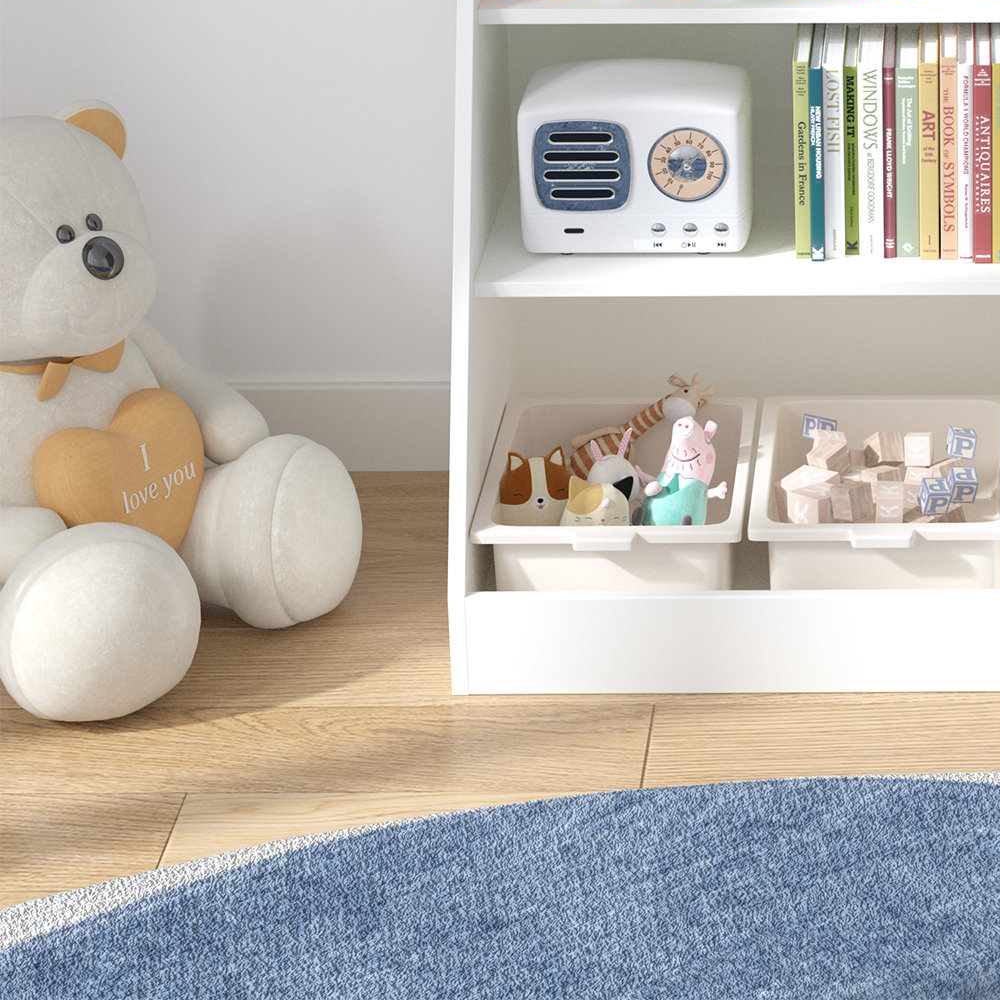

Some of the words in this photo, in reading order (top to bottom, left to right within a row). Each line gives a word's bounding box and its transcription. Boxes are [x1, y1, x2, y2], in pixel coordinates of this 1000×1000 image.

[826, 69, 840, 112] LOST
[846, 75, 855, 123] MAKING
[798, 121, 807, 160] Gardens
[826, 116, 840, 153] FISH
[846, 125, 855, 138] IT
[922, 110, 936, 141] ART
[943, 106, 955, 146] BOOK
[798, 162, 807, 172] in
[815, 147, 823, 179] HOUSING
[980, 115, 991, 214] ANTIQUAIRES
[798, 174, 807, 206] France
[943, 162, 956, 233] SYMBOLS
[804, 417, 816, 436] P
[139, 443, 152, 472] I
[953, 437, 974, 456] P
[121, 482, 159, 514] love
[161, 461, 197, 500] you
[953, 485, 975, 501] P
[927, 497, 948, 513] P
